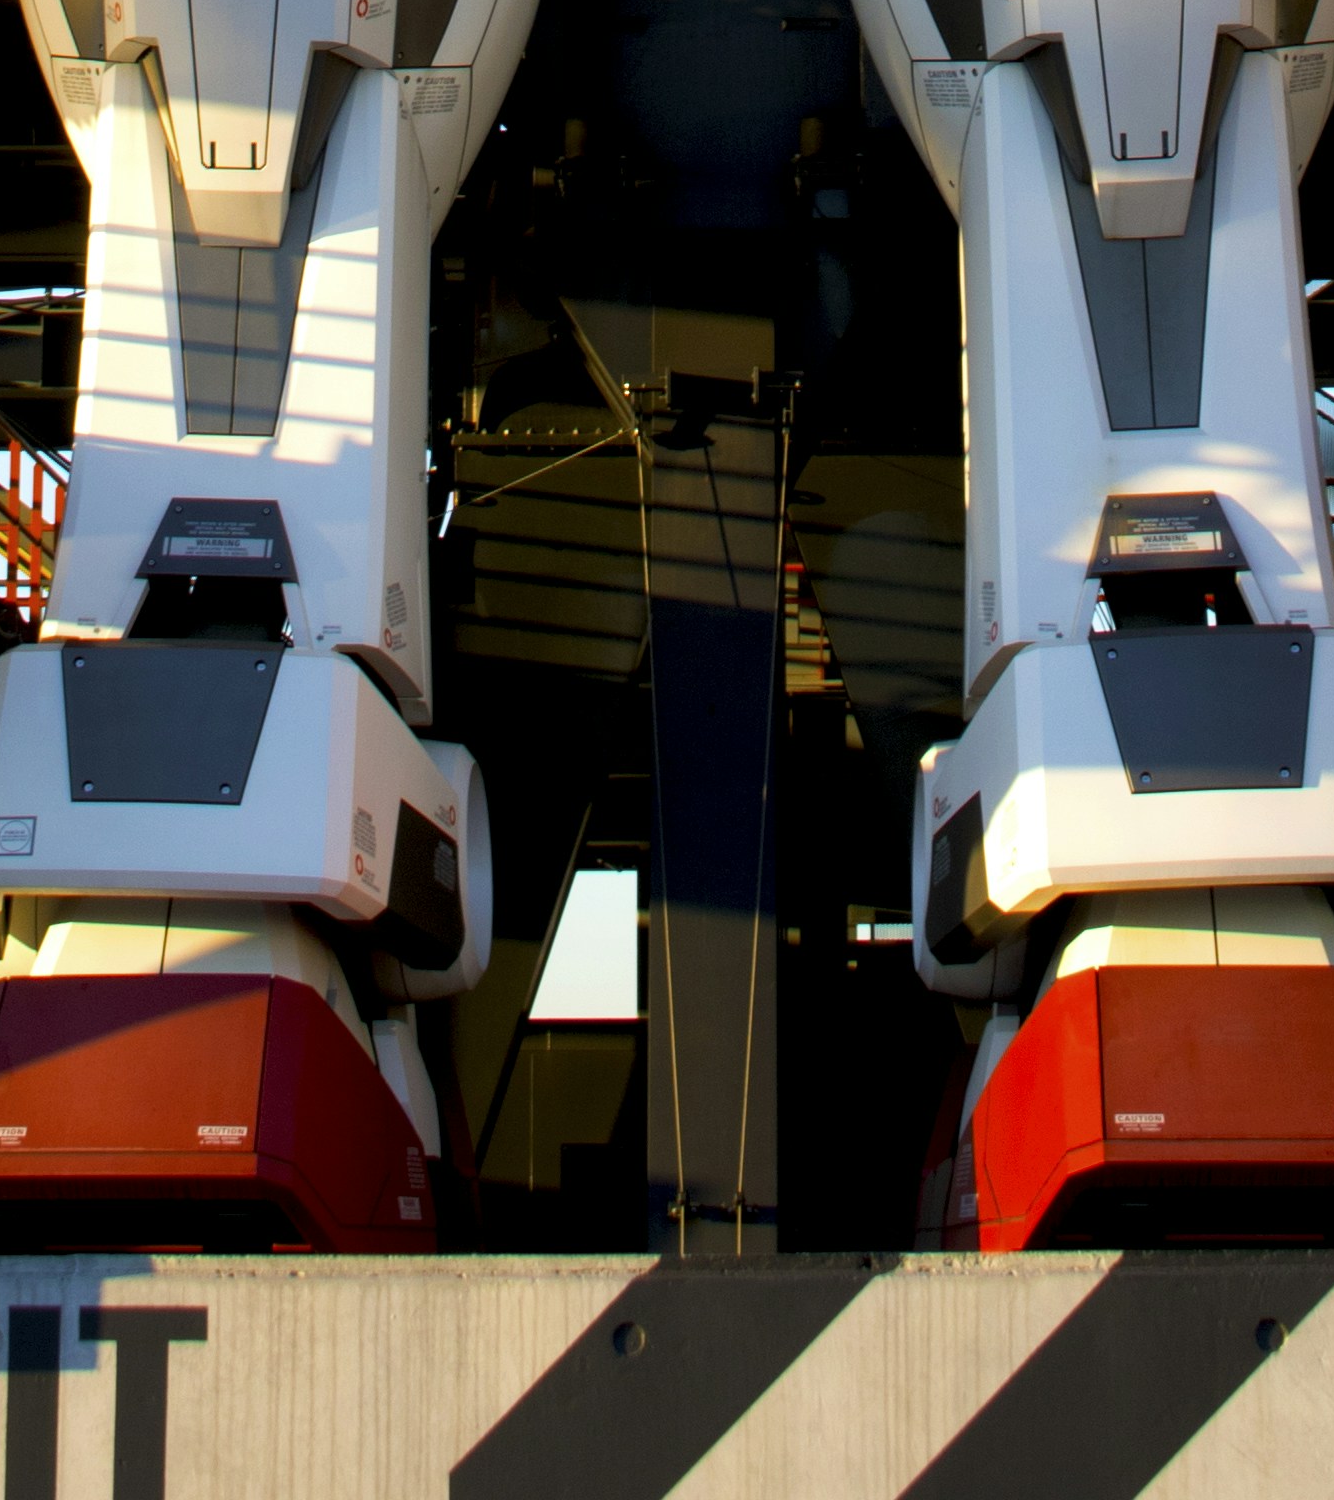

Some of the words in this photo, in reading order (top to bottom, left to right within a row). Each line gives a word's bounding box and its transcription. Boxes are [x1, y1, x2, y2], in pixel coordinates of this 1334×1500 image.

[424, 76, 455, 85] CAUTION
[195, 539, 241, 547] WARNING
[1142, 534, 1188, 543] WARNING
